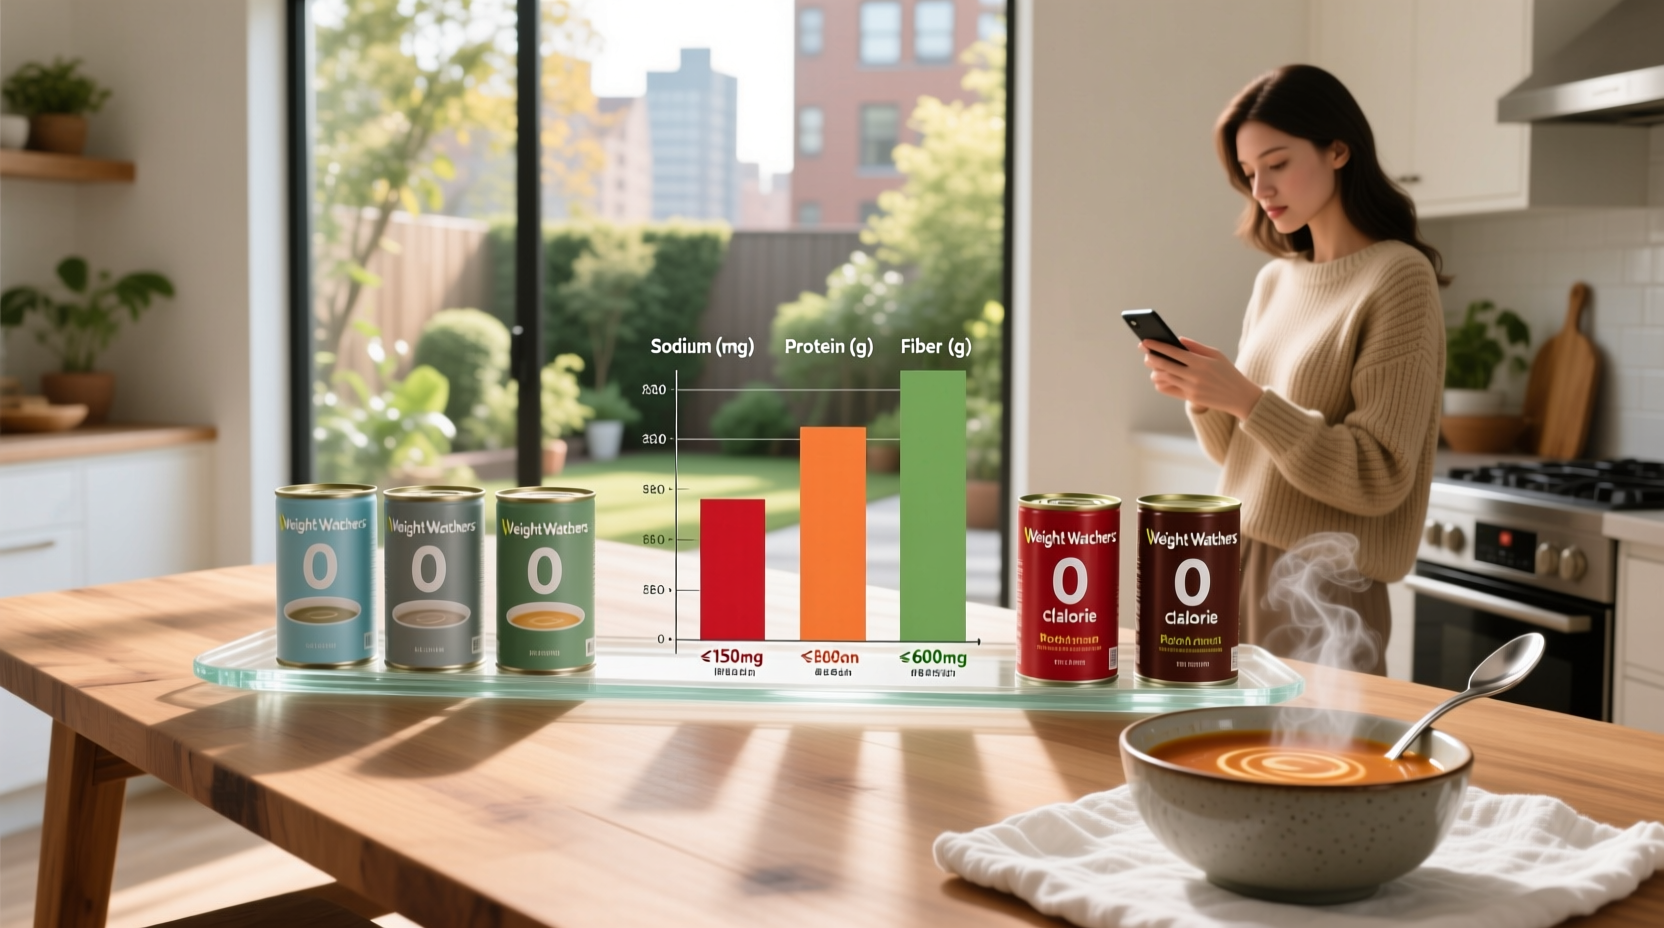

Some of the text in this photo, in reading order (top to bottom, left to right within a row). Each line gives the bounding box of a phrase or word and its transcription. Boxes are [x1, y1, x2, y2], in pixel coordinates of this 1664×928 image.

[1024, 526, 1066, 549] Weight
[302, 543, 338, 590] 0
[411, 545, 447, 594] 0
[527, 546, 563, 595] 0
[1052, 556, 1088, 605] 0
[1174, 558, 1211, 607] 0
